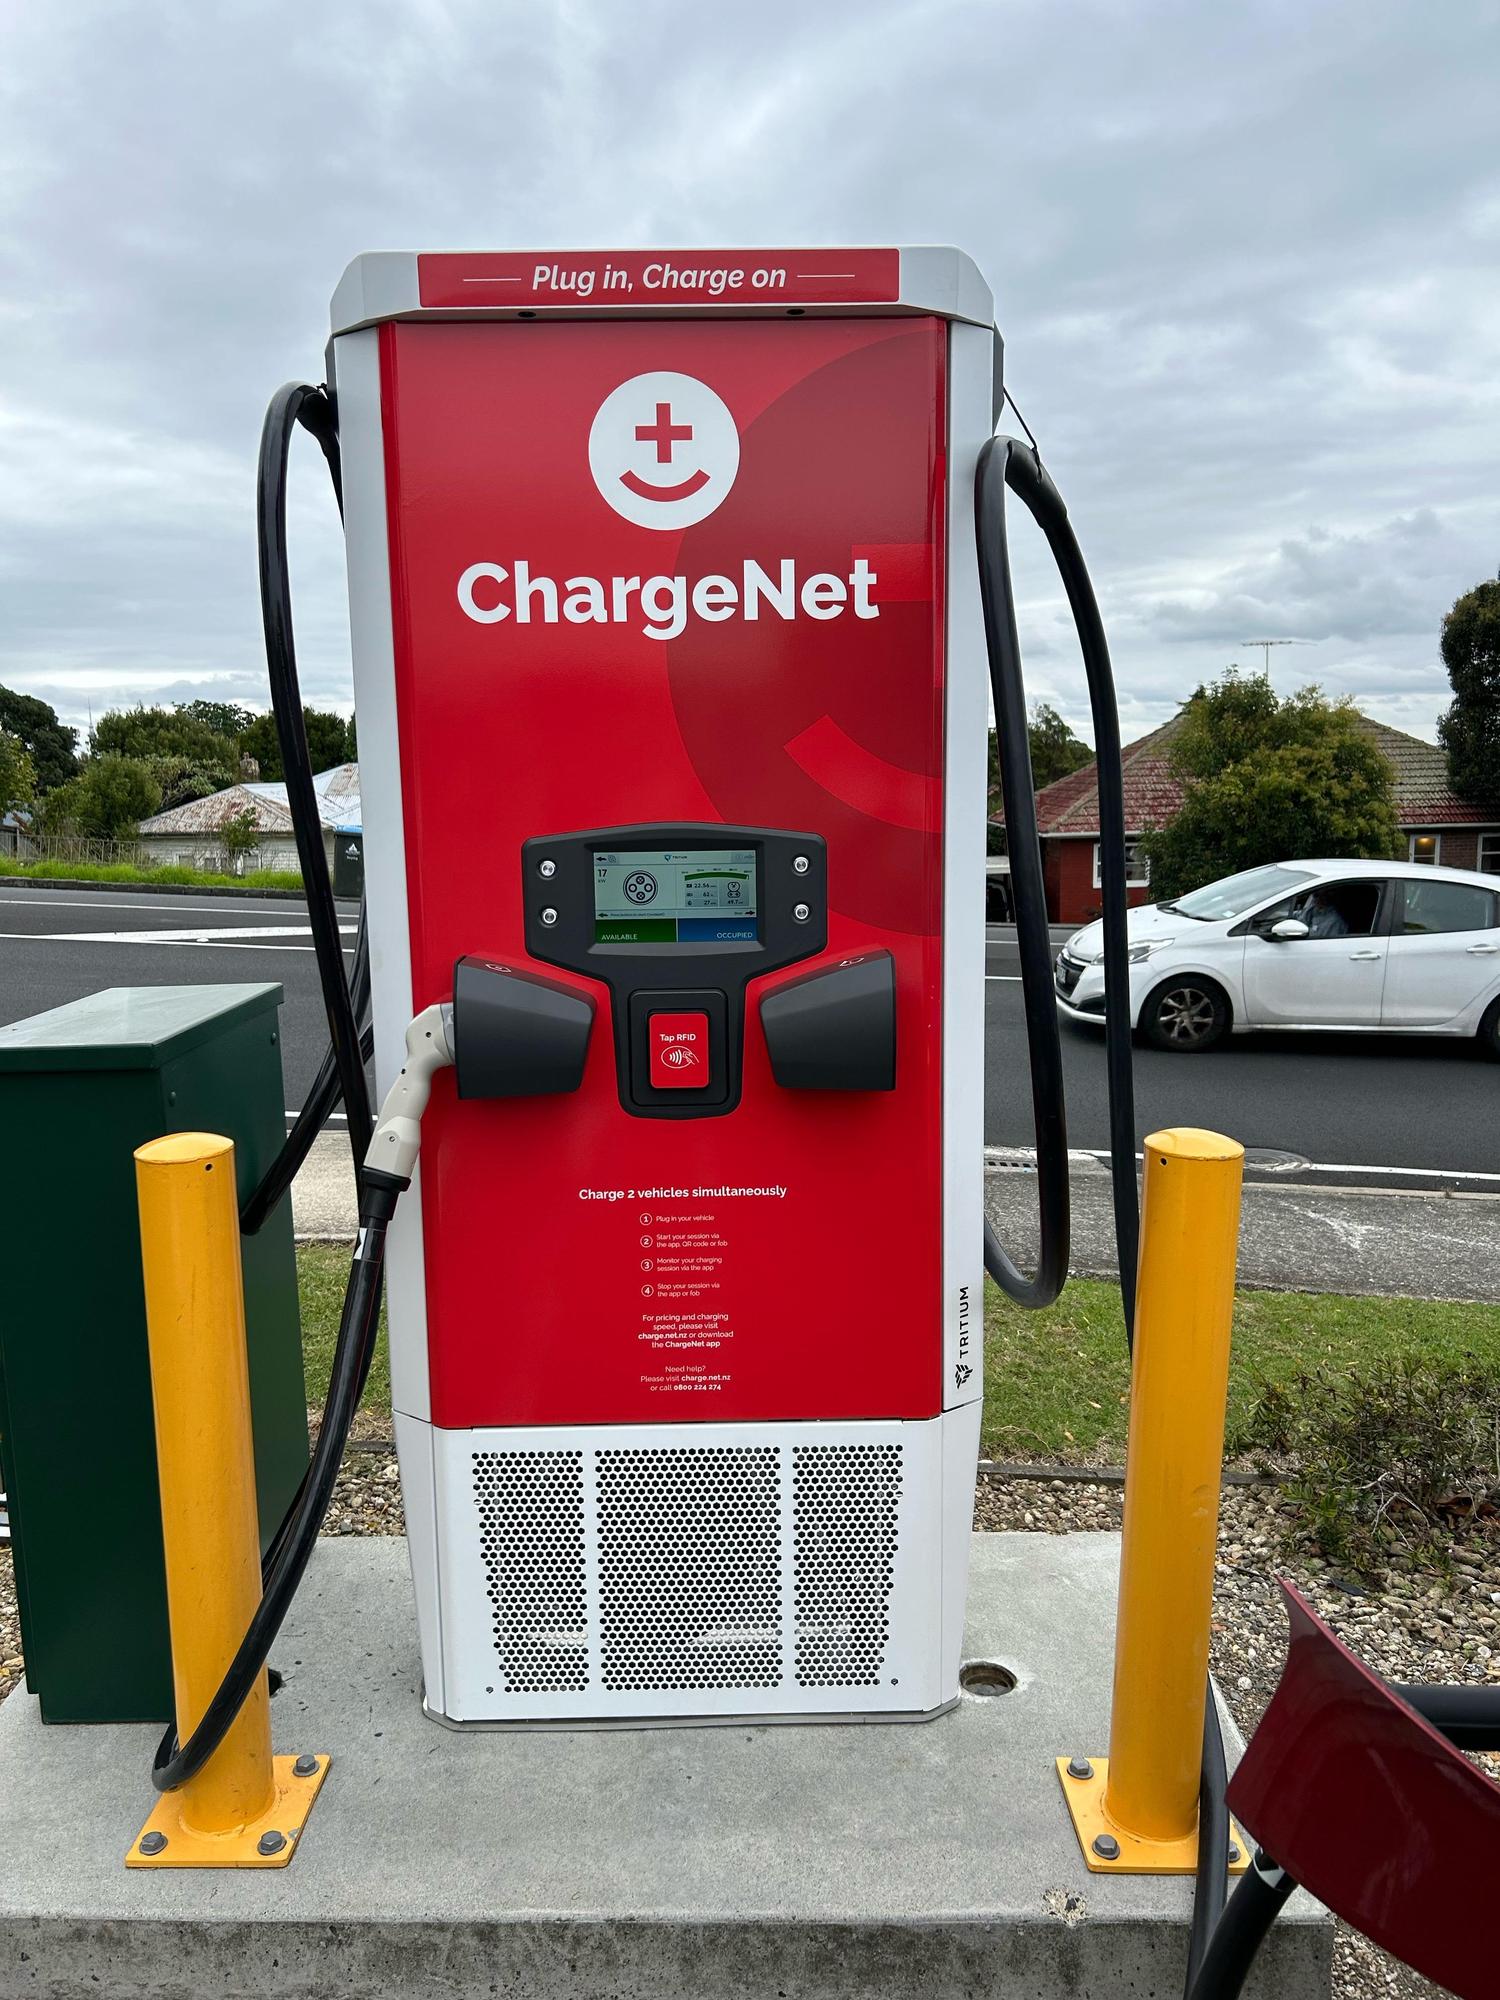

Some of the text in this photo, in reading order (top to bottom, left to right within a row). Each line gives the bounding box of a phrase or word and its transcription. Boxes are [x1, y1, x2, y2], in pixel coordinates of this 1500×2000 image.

[532, 263, 786, 297] Plug in, Charge on
[457, 558, 879, 640] ChargeNet
[660, 1034, 674, 1043] Tap
[579, 1185, 787, 1201] Charge 2 vehicles simultaneously
[960, 1287, 968, 1359] TRITIUM
[665, 1341, 704, 1349] ChargeNet
